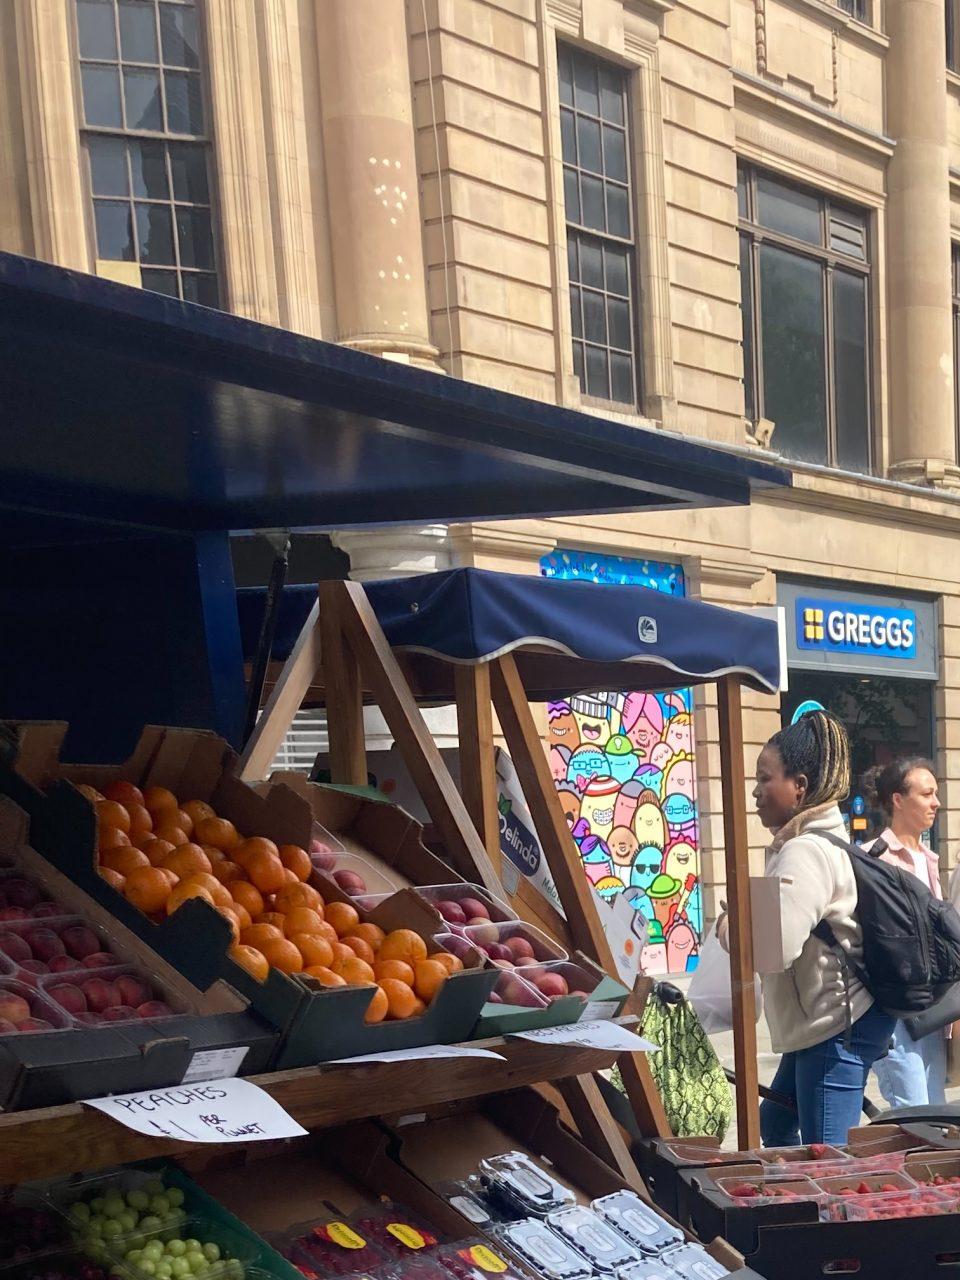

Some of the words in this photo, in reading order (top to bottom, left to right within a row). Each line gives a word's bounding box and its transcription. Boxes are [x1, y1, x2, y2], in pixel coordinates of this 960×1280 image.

[828, 610, 914, 648] GREGGS
[499, 815, 538, 871] elinda
[113, 1086, 227, 1114] PEACHES
[199, 1113, 227, 1127] PER
